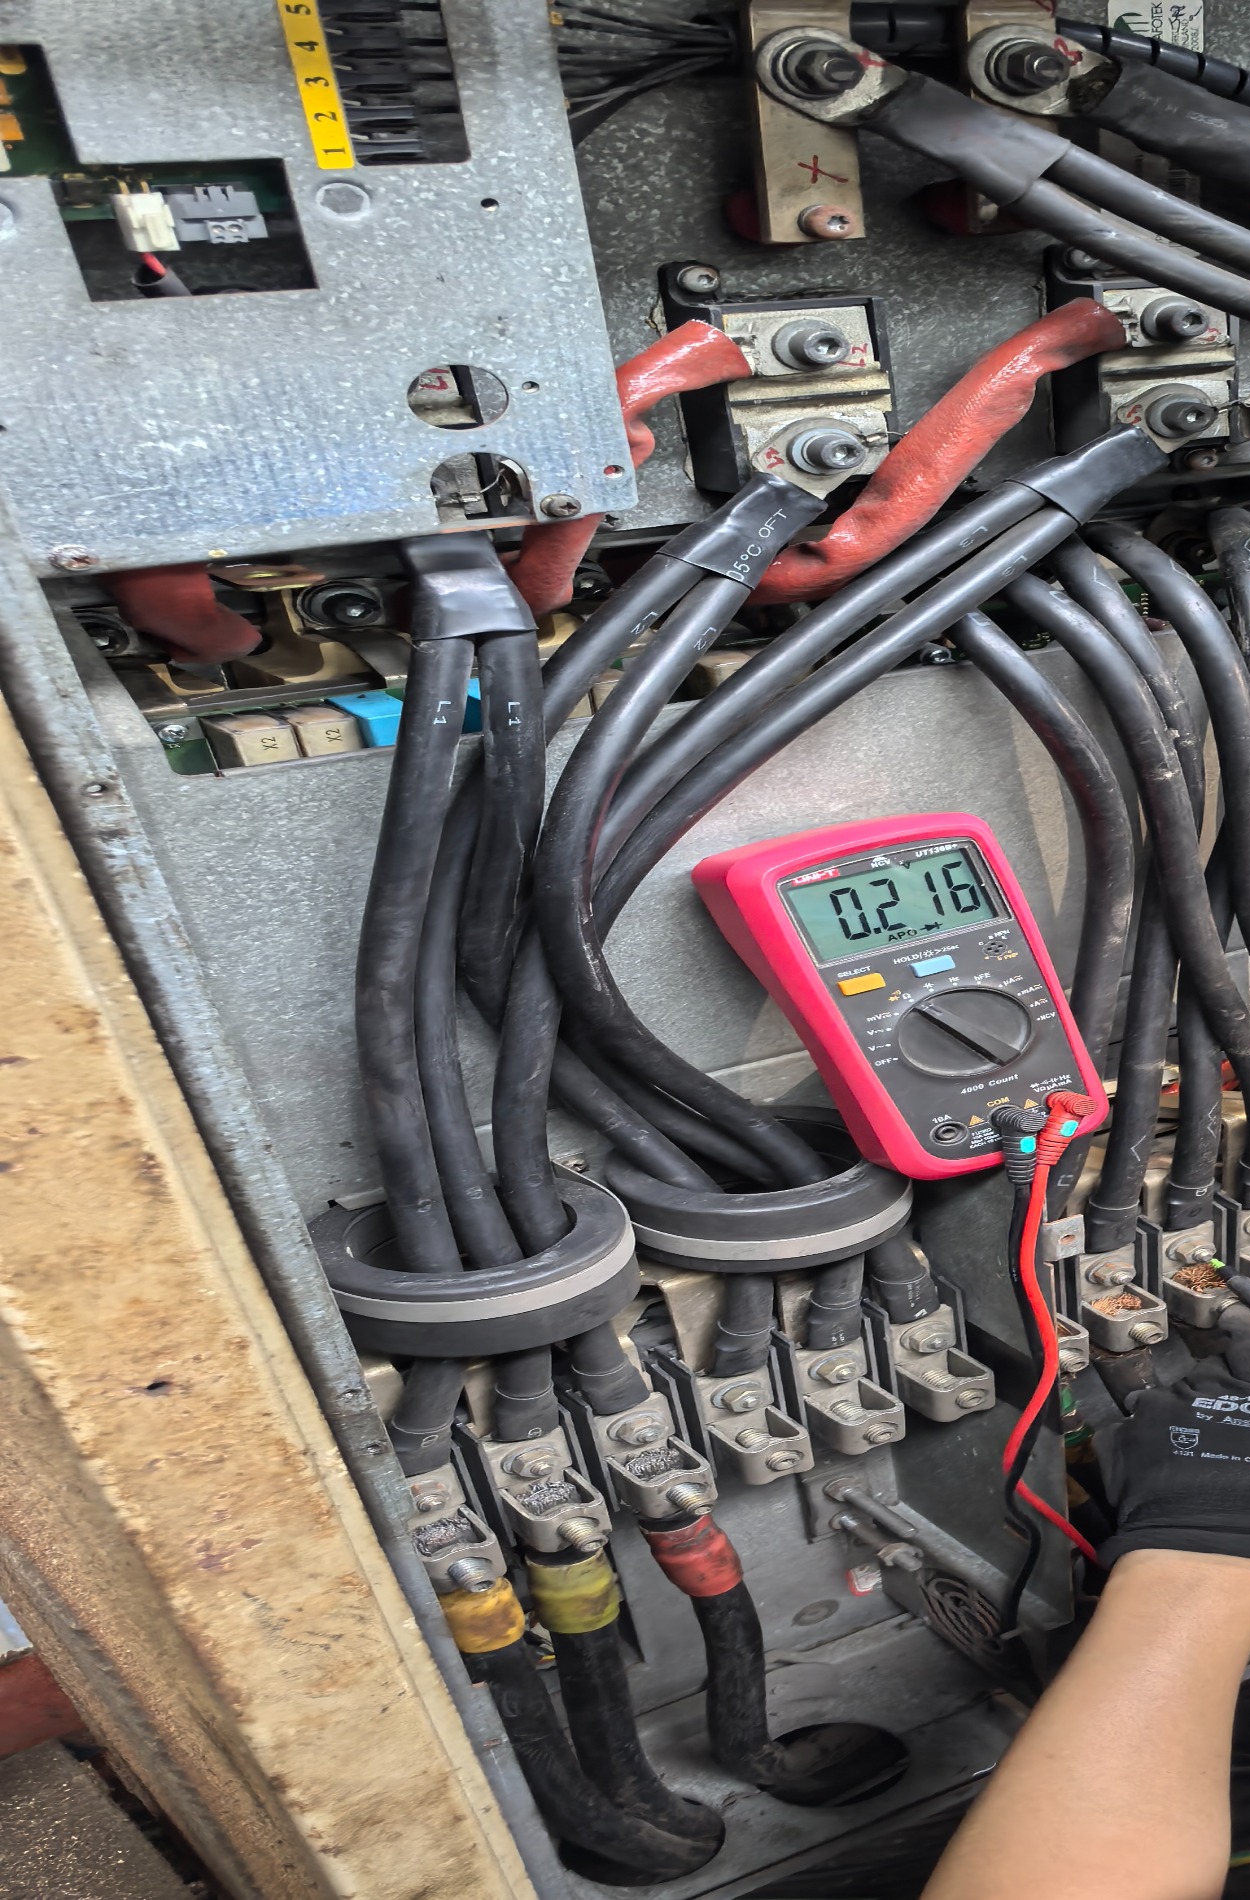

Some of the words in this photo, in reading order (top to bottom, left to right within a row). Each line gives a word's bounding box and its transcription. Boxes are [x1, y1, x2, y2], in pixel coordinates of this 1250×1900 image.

[285, 3, 311, 15] 5
[1150, 1, 1163, 40] AFOTEK
[294, 40, 319, 52] 4
[304, 76, 330, 87] 3
[314, 111, 338, 122] 2
[322, 146, 346, 155] 1
[758, 508, 788, 539] OFT
[508, 701, 522, 727] L1
[325, 728, 343, 743] X2
[261, 736, 279, 751] X2
[870, 858, 891, 869] NCV
[829, 860, 981, 941] 0.216
[888, 929, 918, 942] APO
[837, 966, 872, 978] SELECT
[960, 1083, 985, 1095] 4000
[988, 1073, 1019, 1087] Count
[986, 1096, 1010, 1107] COM
[1195, 1411, 1214, 1421] by
[1200, 1451, 1230, 1461] Made
[1231, 1454, 1242, 1462] in
